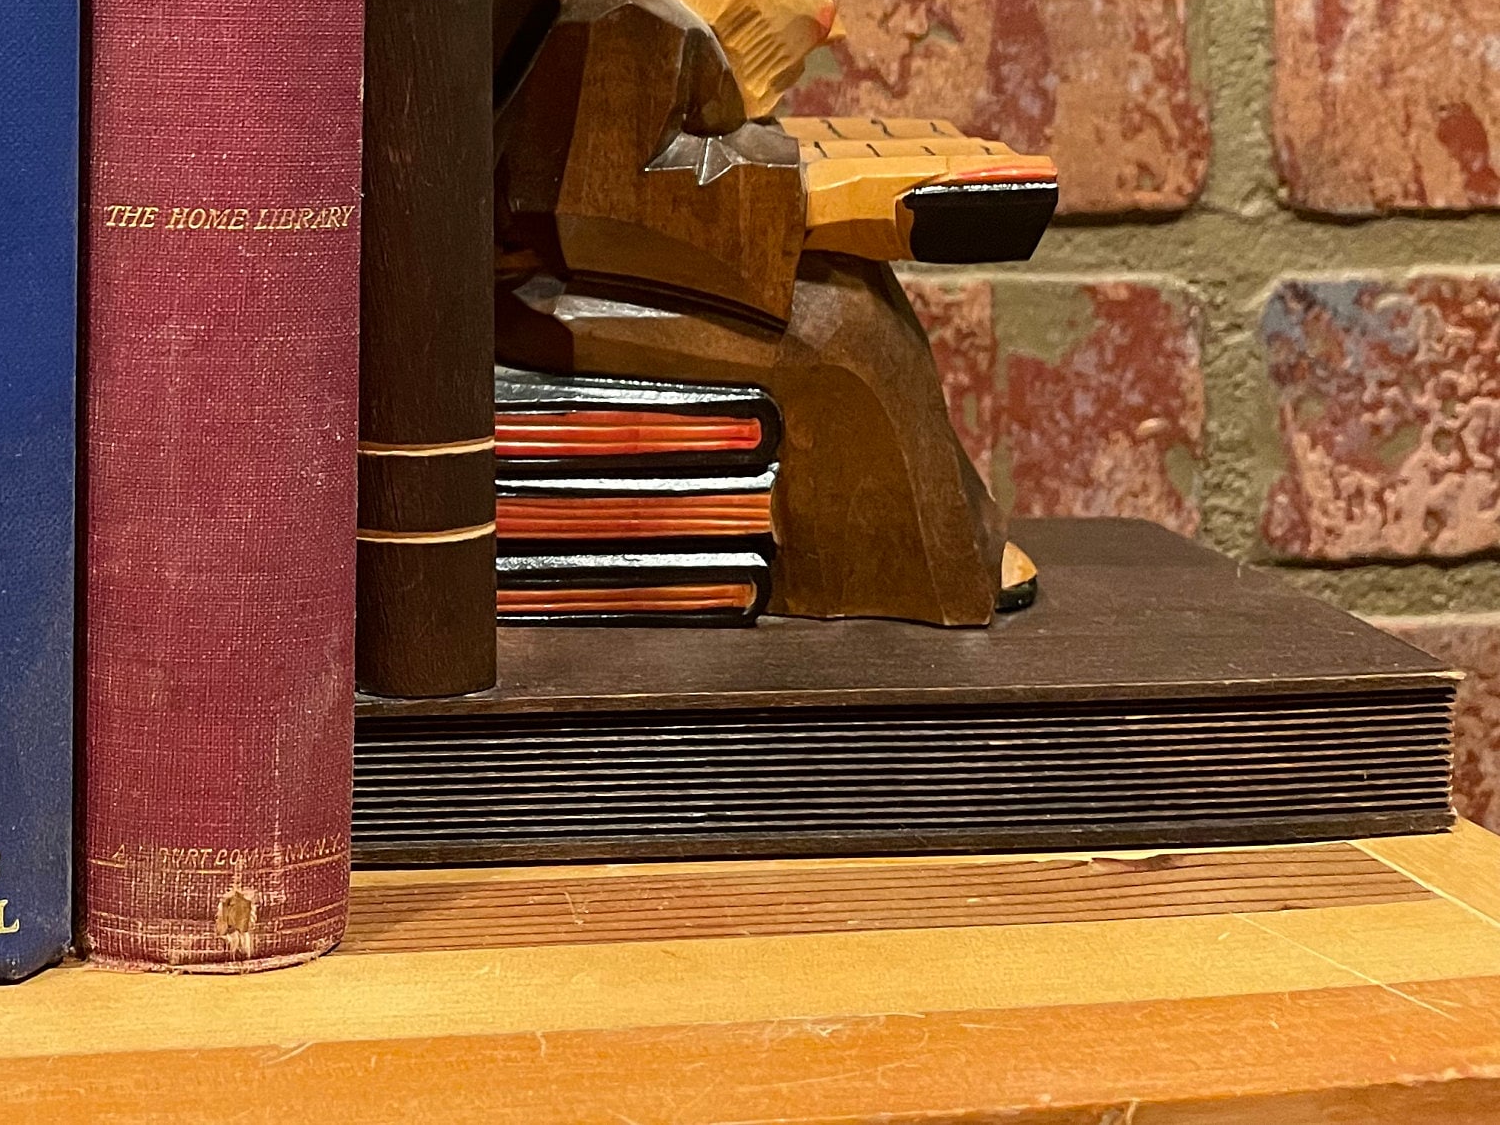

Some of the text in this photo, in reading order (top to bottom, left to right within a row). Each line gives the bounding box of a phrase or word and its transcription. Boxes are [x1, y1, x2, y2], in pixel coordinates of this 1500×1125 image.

[105, 205, 356, 230] THE HOME LIBRARY
